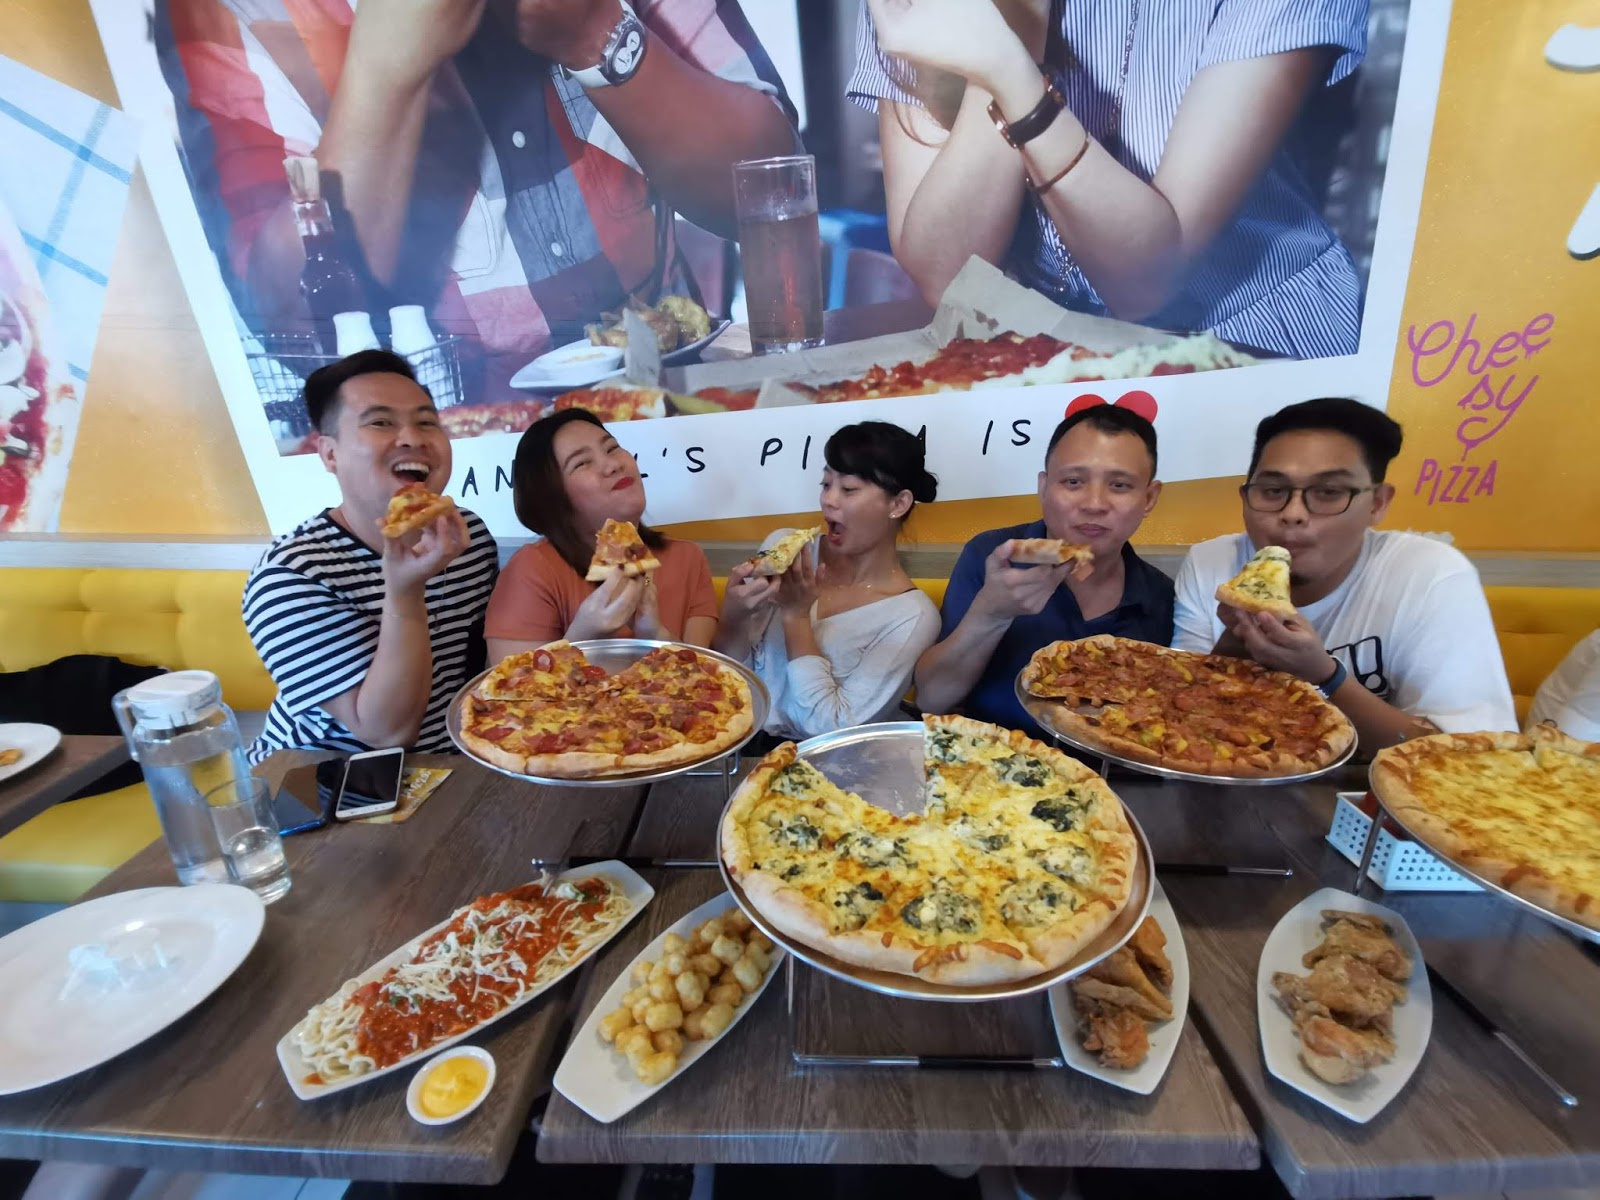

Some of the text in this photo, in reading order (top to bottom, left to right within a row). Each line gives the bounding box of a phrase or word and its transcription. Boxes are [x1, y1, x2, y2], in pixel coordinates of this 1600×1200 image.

[1408, 312, 1555, 388] Chee
[981, 419, 1032, 456] IS
[1413, 458, 1498, 506] PIZZA
